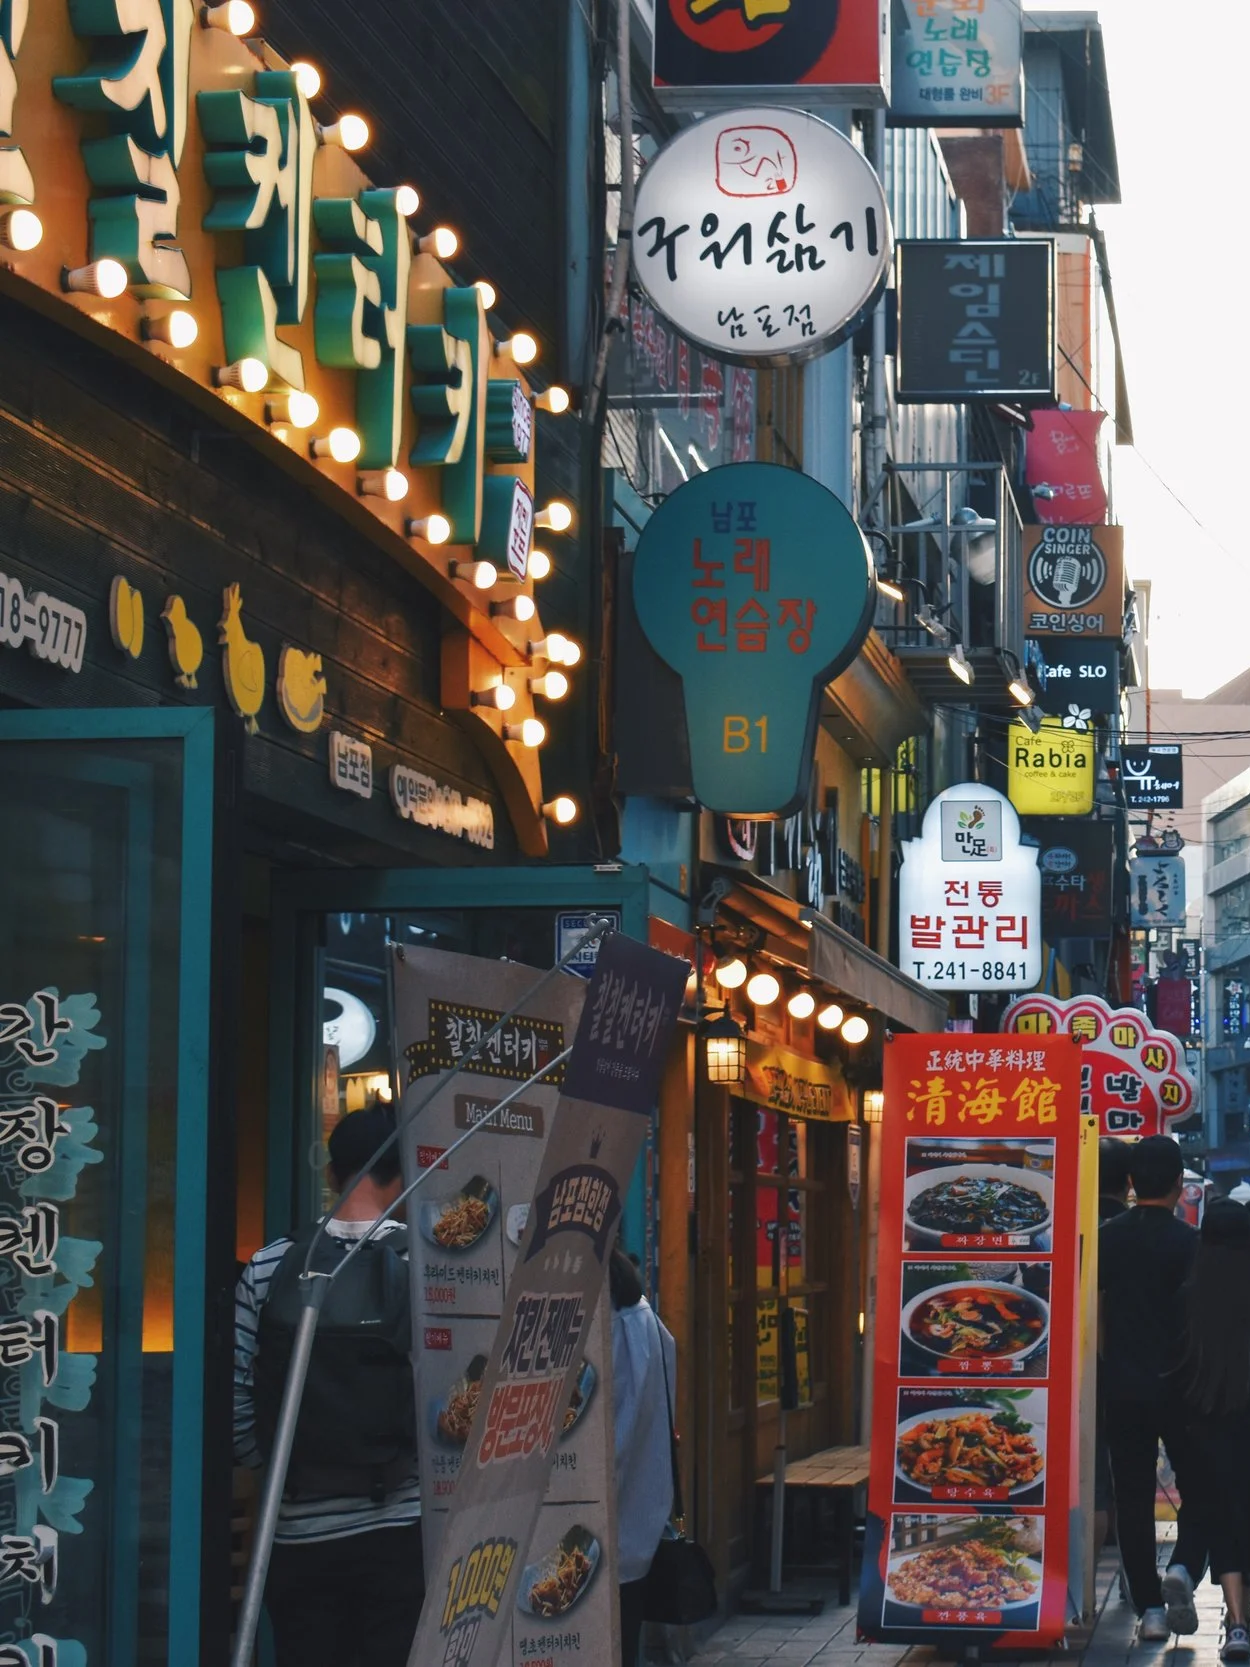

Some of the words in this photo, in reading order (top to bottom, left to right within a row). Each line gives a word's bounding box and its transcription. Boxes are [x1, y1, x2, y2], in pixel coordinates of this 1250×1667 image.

[924, 16, 978, 41] 노래
[906, 48, 991, 77] 연습장
[985, 84, 1011, 104] 3F
[717, 304, 816, 339] 남포점
[944, 254, 1006, 384] 제임스딘
[1019, 370, 1040, 385] 2F
[711, 501, 757, 532] 남포
[1043, 527, 1091, 544] COIN
[1044, 543, 1091, 554] SINGER
[692, 537, 770, 592] 노래
[690, 597, 818, 653] 연습장
[1029, 613, 1103, 632] 코인싱어
[1079, 664, 1107, 679] SLO
[722, 715, 768, 754] B1
[1015, 735, 1042, 747] Cafe
[337, 741, 370, 789] 남포점
[1015, 747, 1087, 768] Rabia
[1024, 770, 1049, 779] coffee
[1058, 770, 1077, 779] cake
[944, 881, 1004, 908] 전통
[910, 914, 1029, 950] 발관리
[912, 961, 1028, 982] T.241-8841
[925, 1048, 1046, 1073] 正統中華料理
[500, 1108, 534, 1132] Menu
